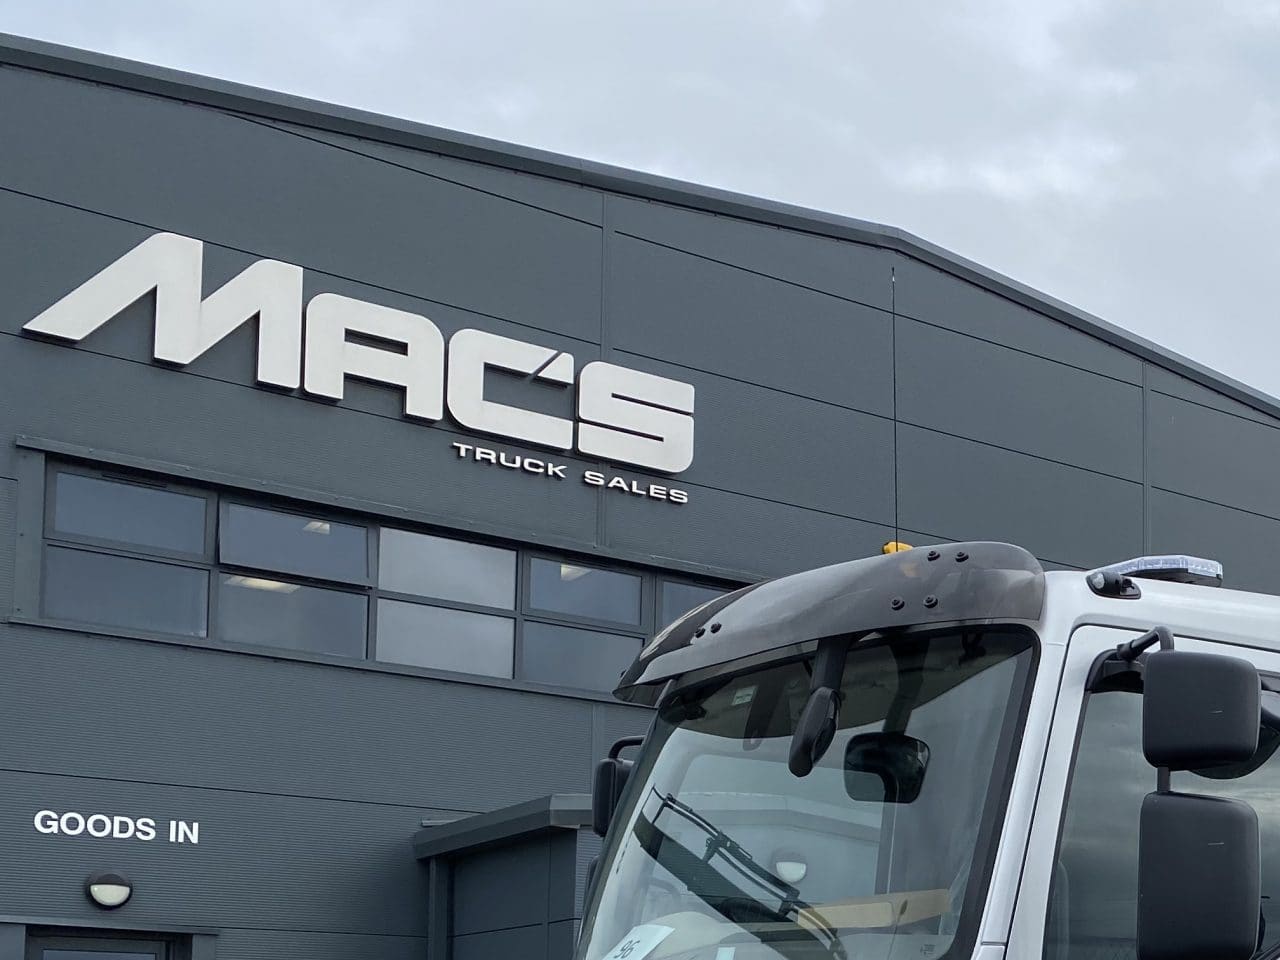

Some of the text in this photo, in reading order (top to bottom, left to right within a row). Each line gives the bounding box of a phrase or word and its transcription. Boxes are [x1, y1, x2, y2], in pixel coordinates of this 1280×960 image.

[453, 442, 689, 504] TRUCK SALES
[33, 810, 199, 844] GOODS IN
